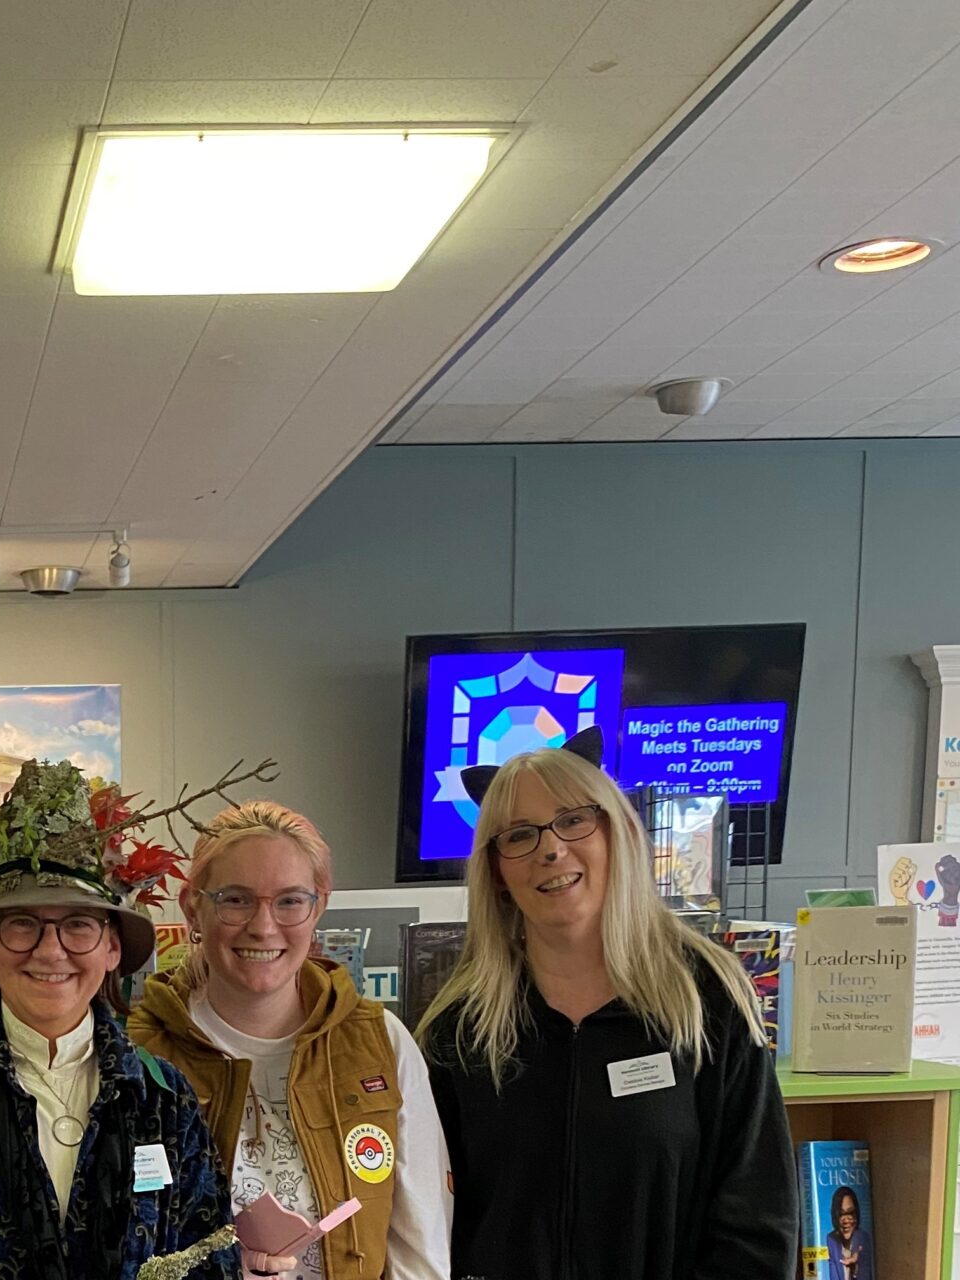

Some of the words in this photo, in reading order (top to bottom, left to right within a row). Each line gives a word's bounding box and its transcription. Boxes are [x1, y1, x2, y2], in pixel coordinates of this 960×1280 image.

[628, 720, 673, 737] Magic
[677, 720, 701, 733] the
[705, 717, 780, 733] Gathering
[642, 740, 686, 754] Meets
[691, 738, 761, 754] Tuesdays
[667, 763, 686, 773] on
[690, 759, 733, 773] Zoom
[707, 778, 761, 794] 9:00pm
[805, 949, 907, 969] Leadership
[365, 973, 397, 997] TI
[830, 973, 878, 990] Henry
[817, 991, 891, 1006] Kissinger
[826, 1012, 840, 1020] Six
[844, 1011, 879, 1020] Studies
[822, 1023, 851, 1031] World
[854, 1023, 893, 1032] Strategy
[348, 1128, 374, 1170] PROFESSIONAL
[378, 1132, 392, 1168] TRAINER
[818, 1169, 870, 1186] CHOSEN
[803, 1251, 817, 1259] EW
